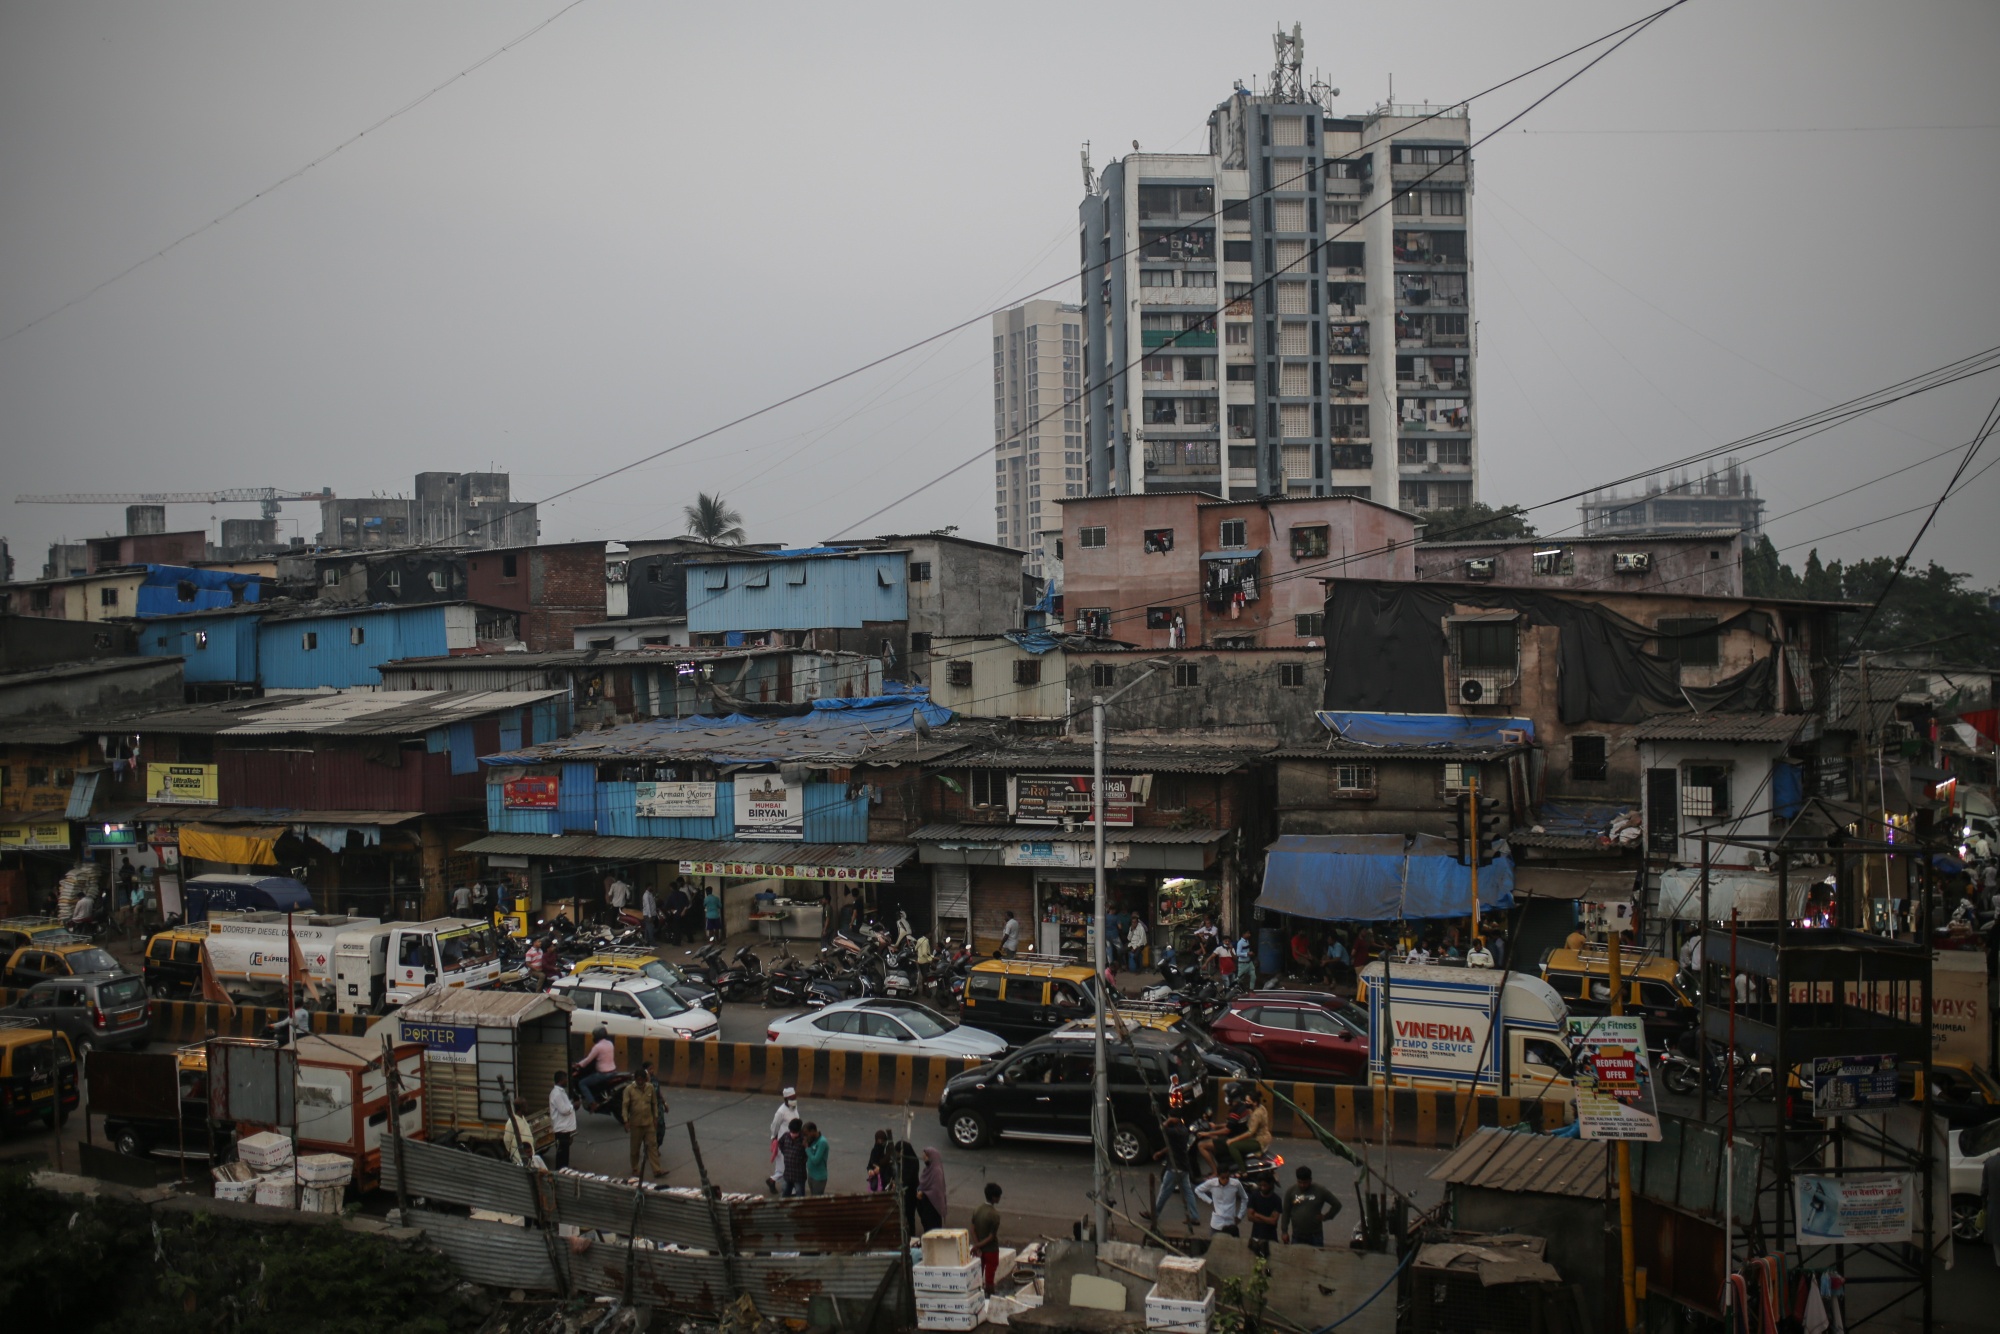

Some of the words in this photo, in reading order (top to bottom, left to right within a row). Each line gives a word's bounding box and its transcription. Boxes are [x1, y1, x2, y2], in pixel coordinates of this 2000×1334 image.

[173, 777, 201, 785] UltraTech
[657, 791, 685, 800] Armaan
[686, 789, 713, 800] Motors
[749, 809, 788, 818] BIRYANI
[223, 925, 257, 935] DOORSTEP
[258, 927, 280, 936] DIESEL
[1607, 1021, 1637, 1030] Fitness
[1932, 1023, 1966, 1032] MUMBAI
[404, 1027, 455, 1044] PORTER
[1395, 1020, 1475, 1043] VINEDHA
[1395, 1038, 1429, 1050] TEMPO
[1431, 1041, 1474, 1054] SERVICE
[1595, 1059, 1635, 1068] REOPENING
[1816, 1060, 1843, 1073] OFFER
[1605, 1071, 1628, 1080] OFFER
[1840, 1209, 1878, 1217] VACCINE
[1880, 1207, 1905, 1215] DRIVE
